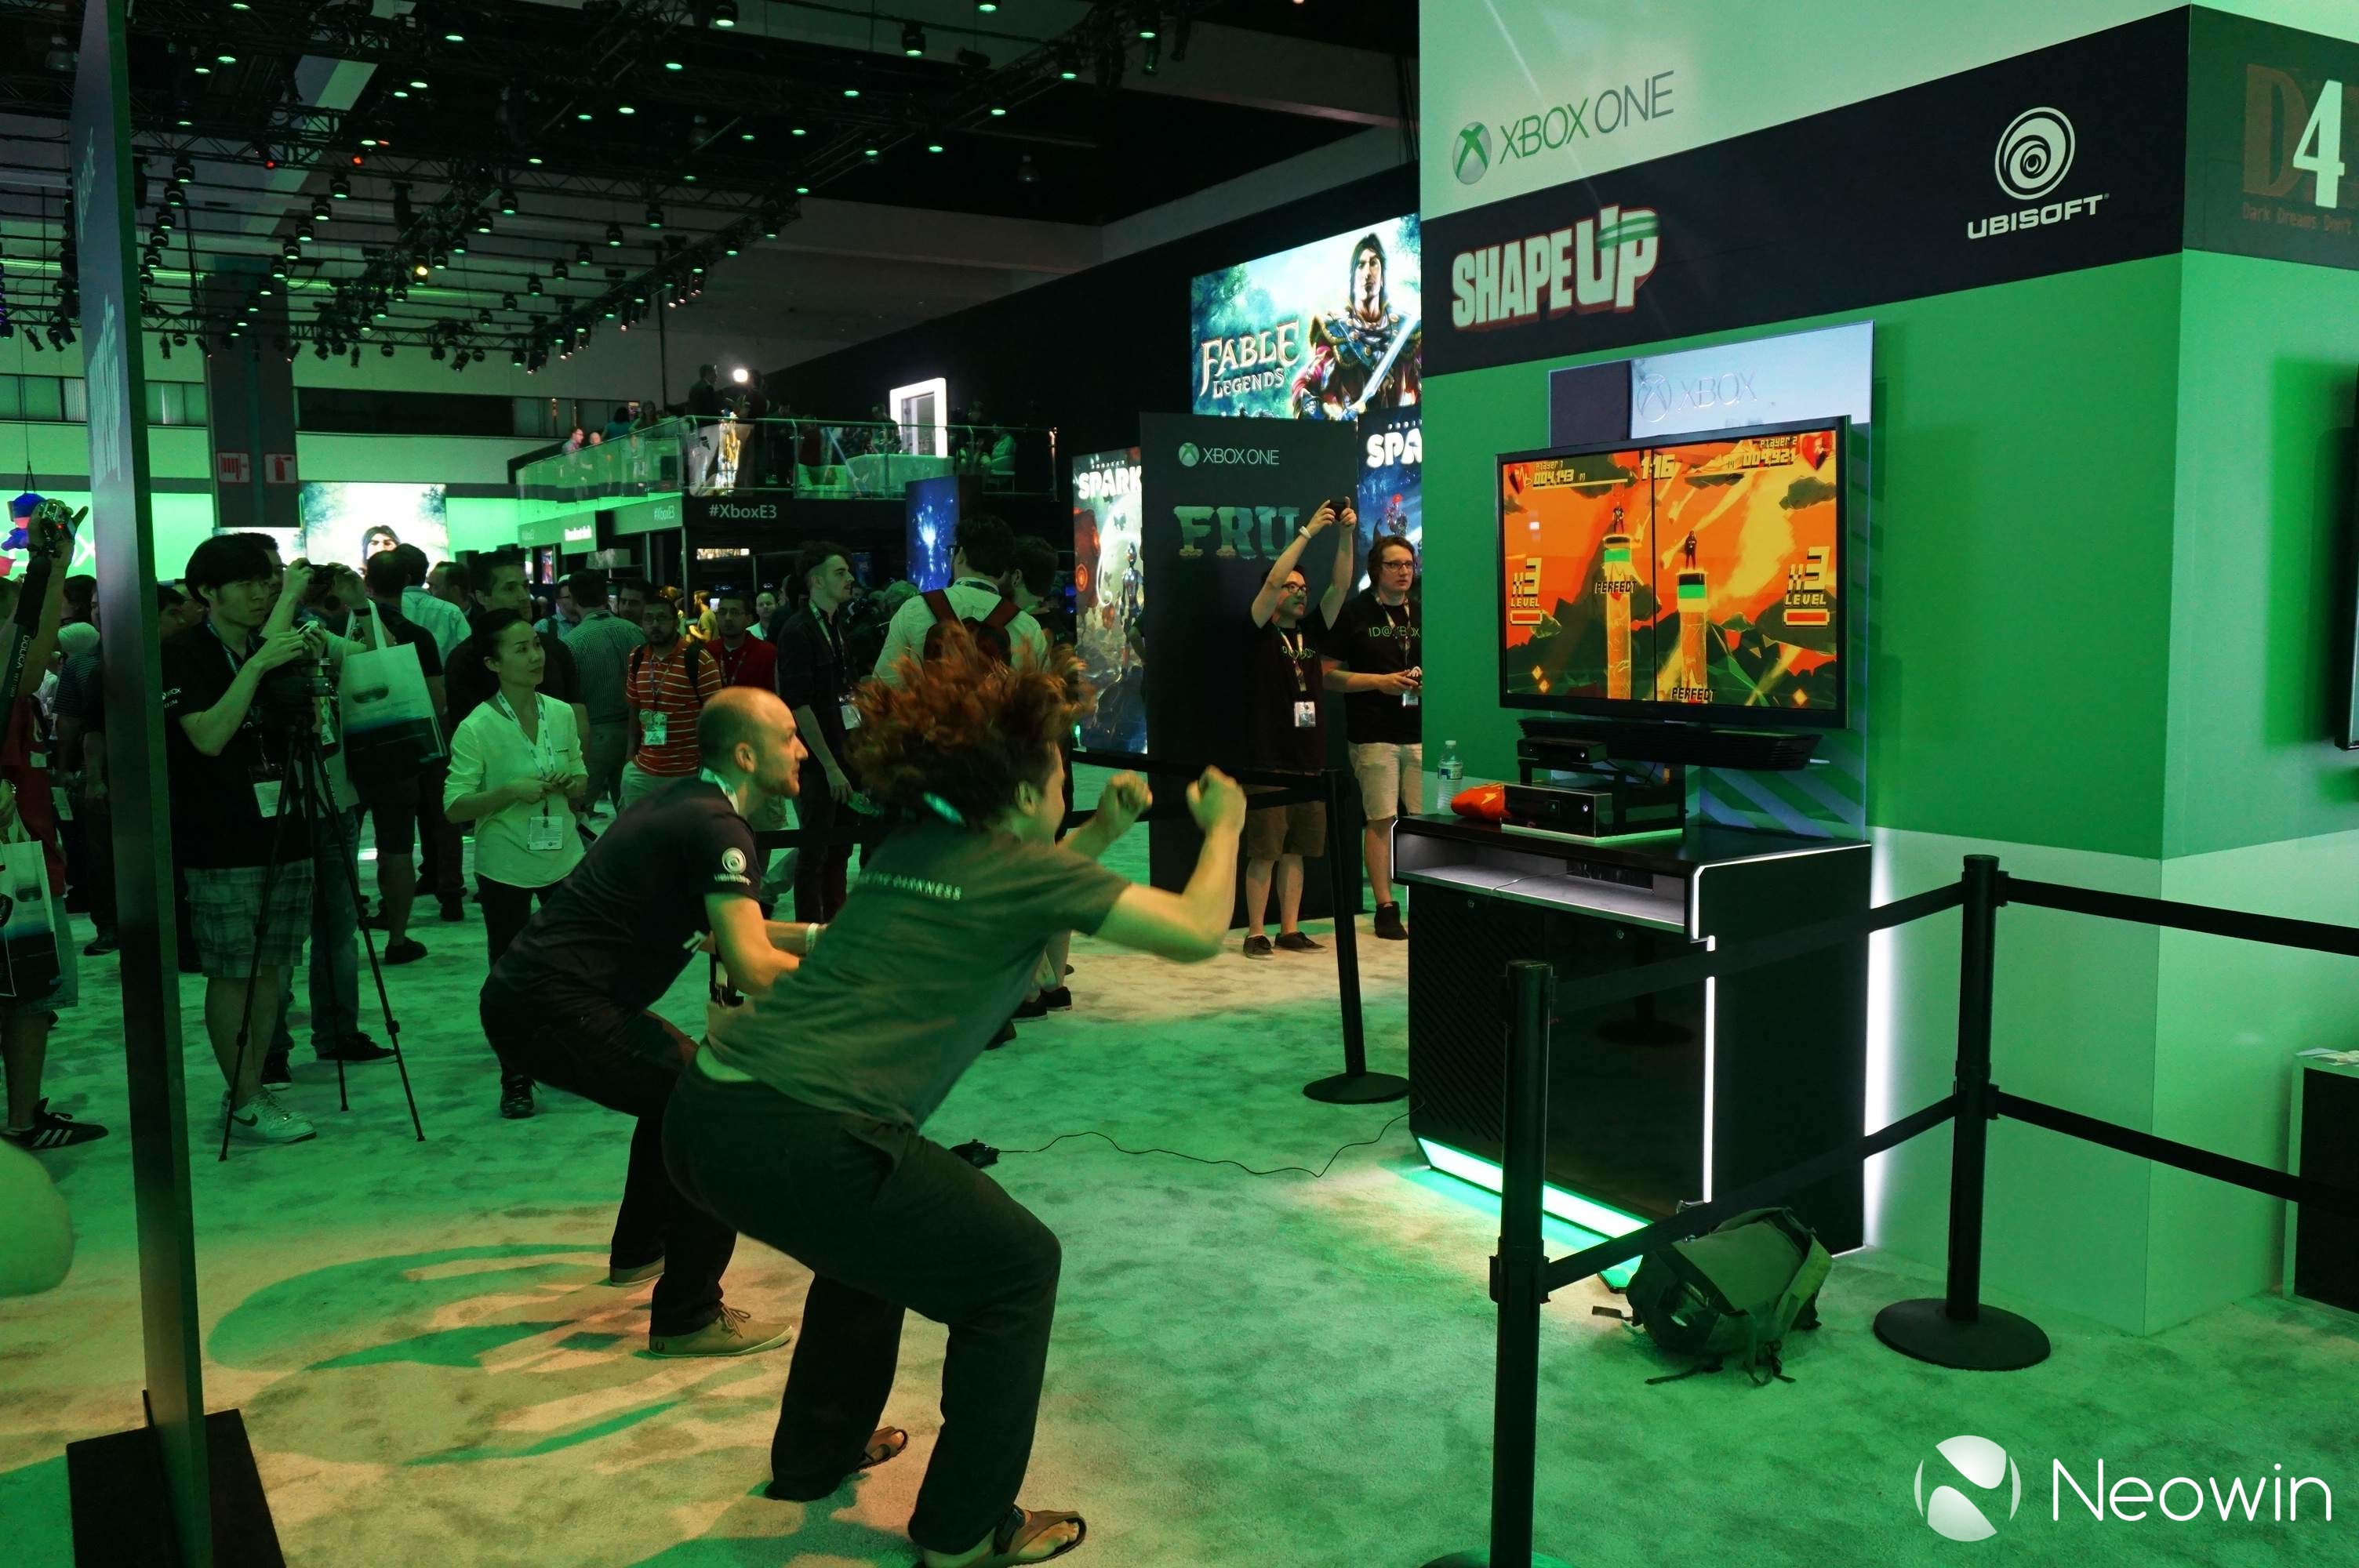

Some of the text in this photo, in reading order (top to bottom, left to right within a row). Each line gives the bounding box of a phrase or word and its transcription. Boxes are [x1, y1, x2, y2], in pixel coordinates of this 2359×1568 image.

[1499, 70, 1674, 165] XBOX ONE
[1967, 194, 2104, 239] UBISOFT
[1199, 318, 1300, 397] FABLE
[1212, 367, 1285, 399] LEGENDS
[1676, 370, 1758, 413] XBOX
[1202, 447, 1280, 465] XBOX ONE
[1078, 465, 1143, 499] SPARK
[709, 503, 777, 518] #XboxE3
[1173, 506, 1300, 561] FRU
[1510, 597, 1540, 608] LEVEL
[1594, 580, 1637, 594] PERFECT
[1784, 593, 1826, 605] LEVEL
[1670, 687, 1717, 702] PERFECT
